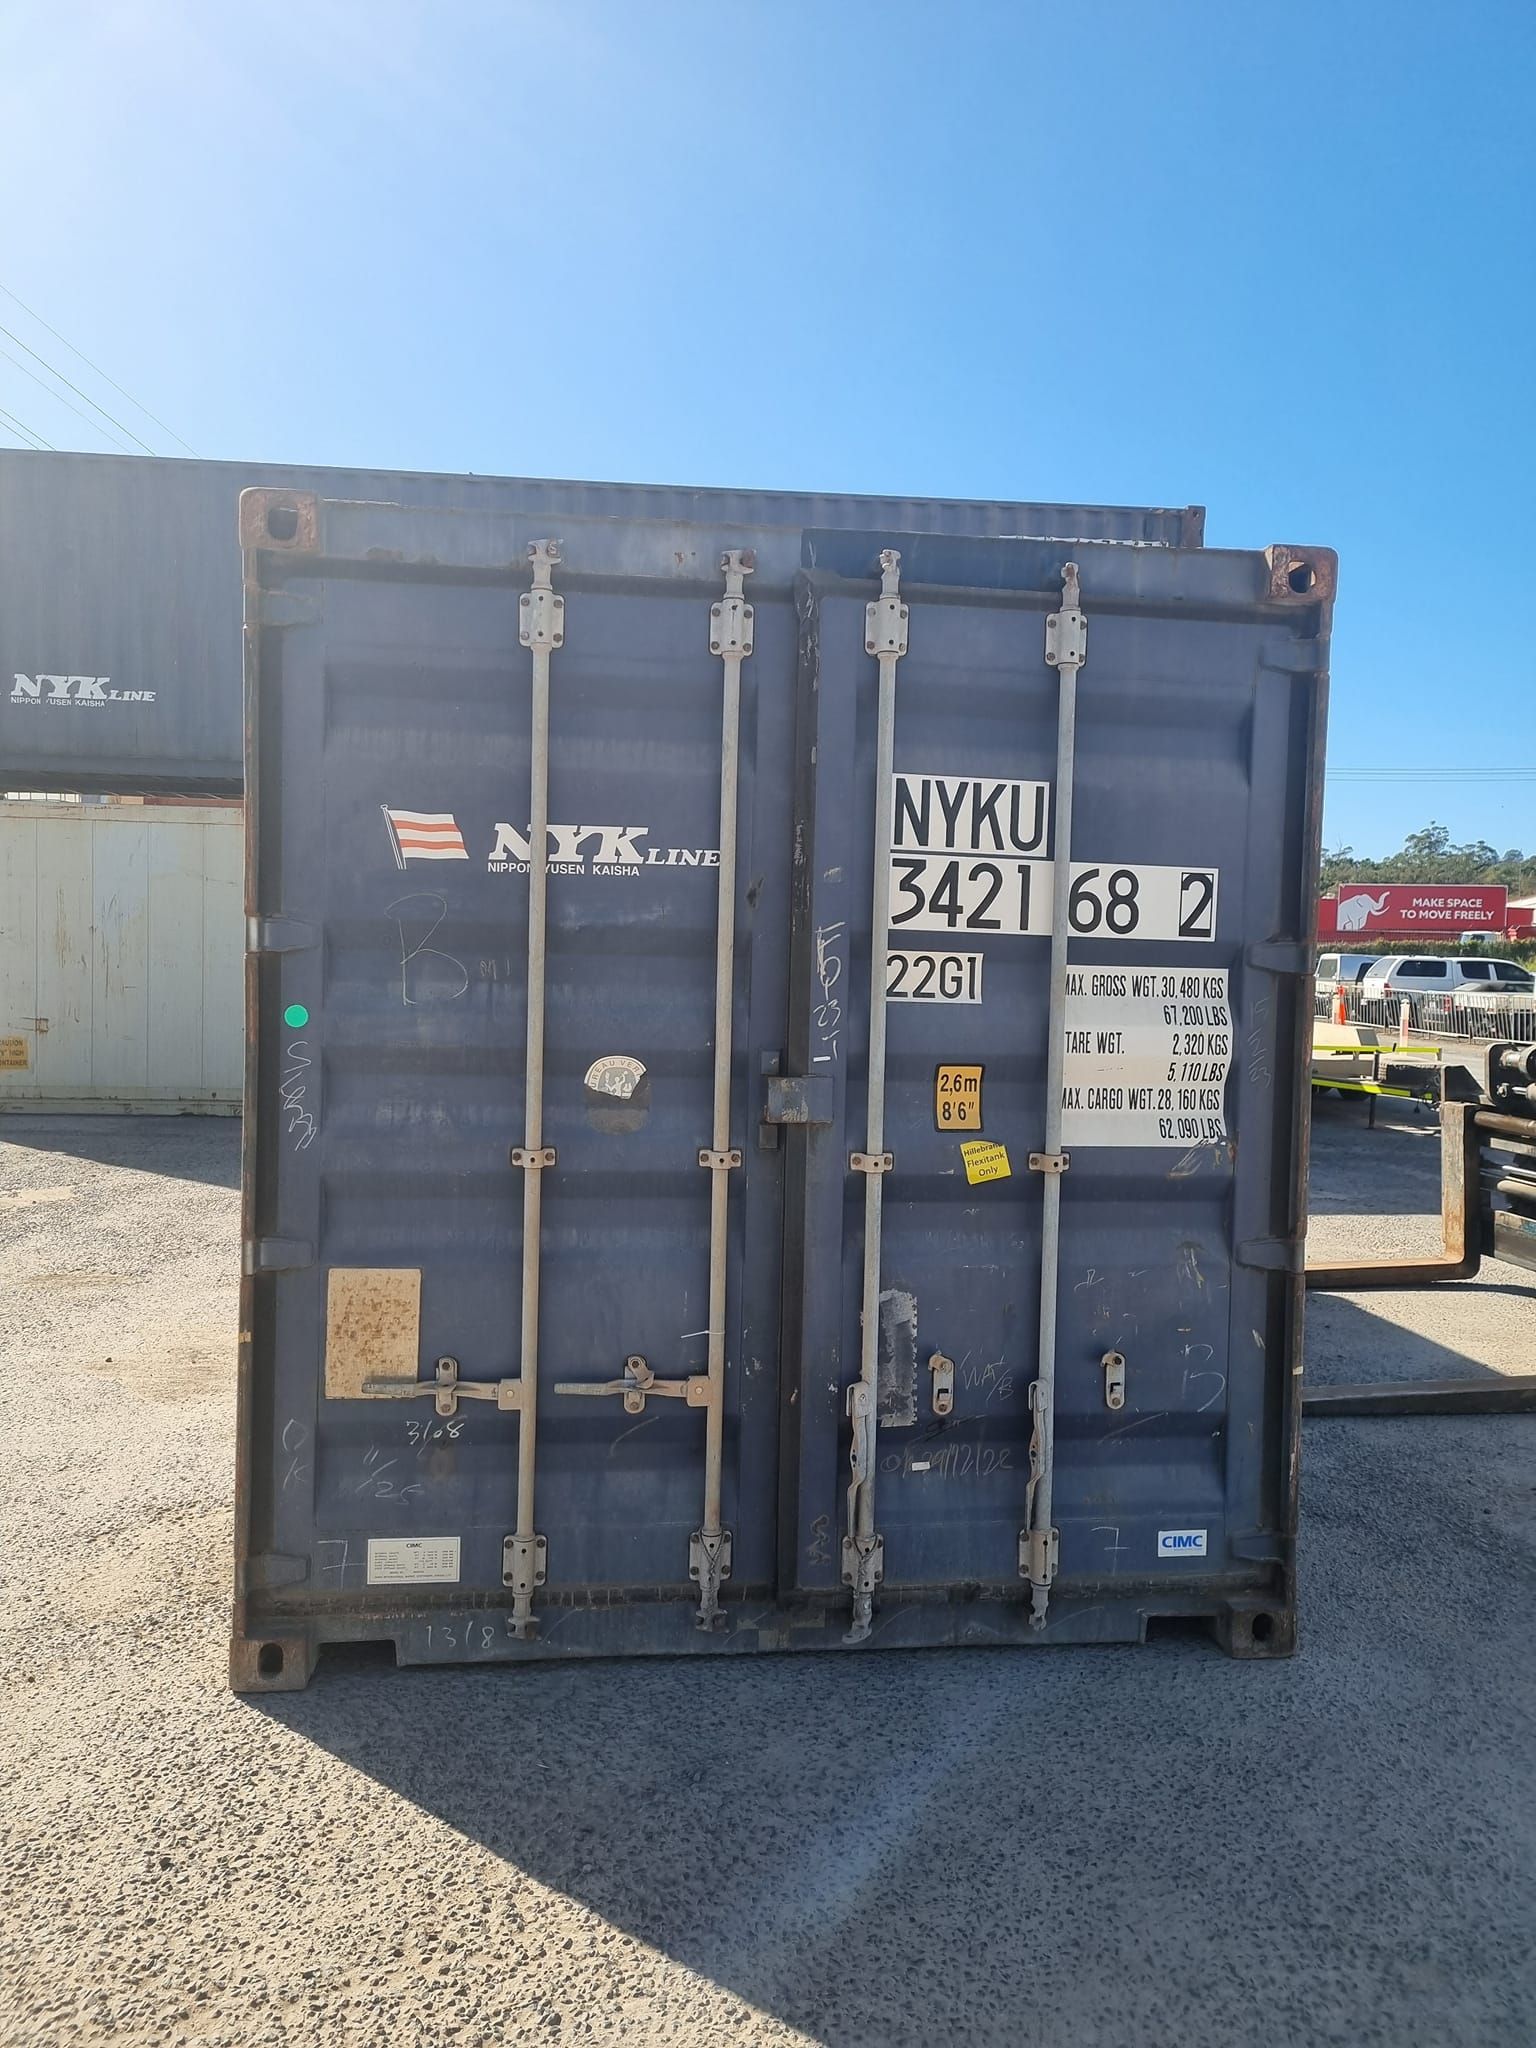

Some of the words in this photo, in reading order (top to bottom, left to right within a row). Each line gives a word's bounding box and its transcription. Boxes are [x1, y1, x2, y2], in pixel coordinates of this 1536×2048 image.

[11, 673, 110, 700] NYK
[106, 689, 156, 701] LINE
[11, 697, 41, 705] NIPPON
[45, 698, 71, 706] USEN
[75, 699, 105, 707] KAISHA
[893, 777, 1045, 851] NYKU
[488, 823, 648, 864] NYK
[645, 848, 721, 866] LINE
[592, 864, 640, 876] KAISHA
[1179, 872, 1214, 937] 2
[1412, 898, 1445, 908] MAKE
[1447, 898, 1483, 908] SPACE
[1400, 909, 1417, 919] TO
[1419, 910, 1451, 920] MOVE
[1454, 910, 1495, 920] FREELY
[1091, 974, 1127, 997] GROSS
[1132, 975, 1159, 998] WGT.
[1161, 976, 1200, 999] 30,480
[1203, 977, 1224, 999] KGS
[1163, 1005, 1203, 1026] 67,200
[1205, 1005, 1228, 1026] LBS
[1065, 1031, 1091, 1054] TARE
[1097, 1032, 1125, 1054] WGT.
[1172, 1033, 1204, 1056] 2,320
[1207, 1034, 1229, 1055] KGS
[590, 1060, 615, 1089] UREAU
[620, 1060, 641, 1077] VERI
[1167, 1062, 1201, 1082] 5,110
[1202, 1062, 1225, 1082] LBS
[1088, 1087, 1123, 1111] CARGO
[1128, 1088, 1156, 1110] WGT.
[1157, 1089, 1196, 1112] 28,160
[1199, 1089, 1221, 1111] KGS
[1159, 1118, 1200, 1140] 62,090
[1200, 1118, 1223, 1139] LBS
[967, 1151, 1006, 1168] Flexitank
[978, 1166, 998, 1177] Only
[1162, 1535, 1203, 1548] CIMC
